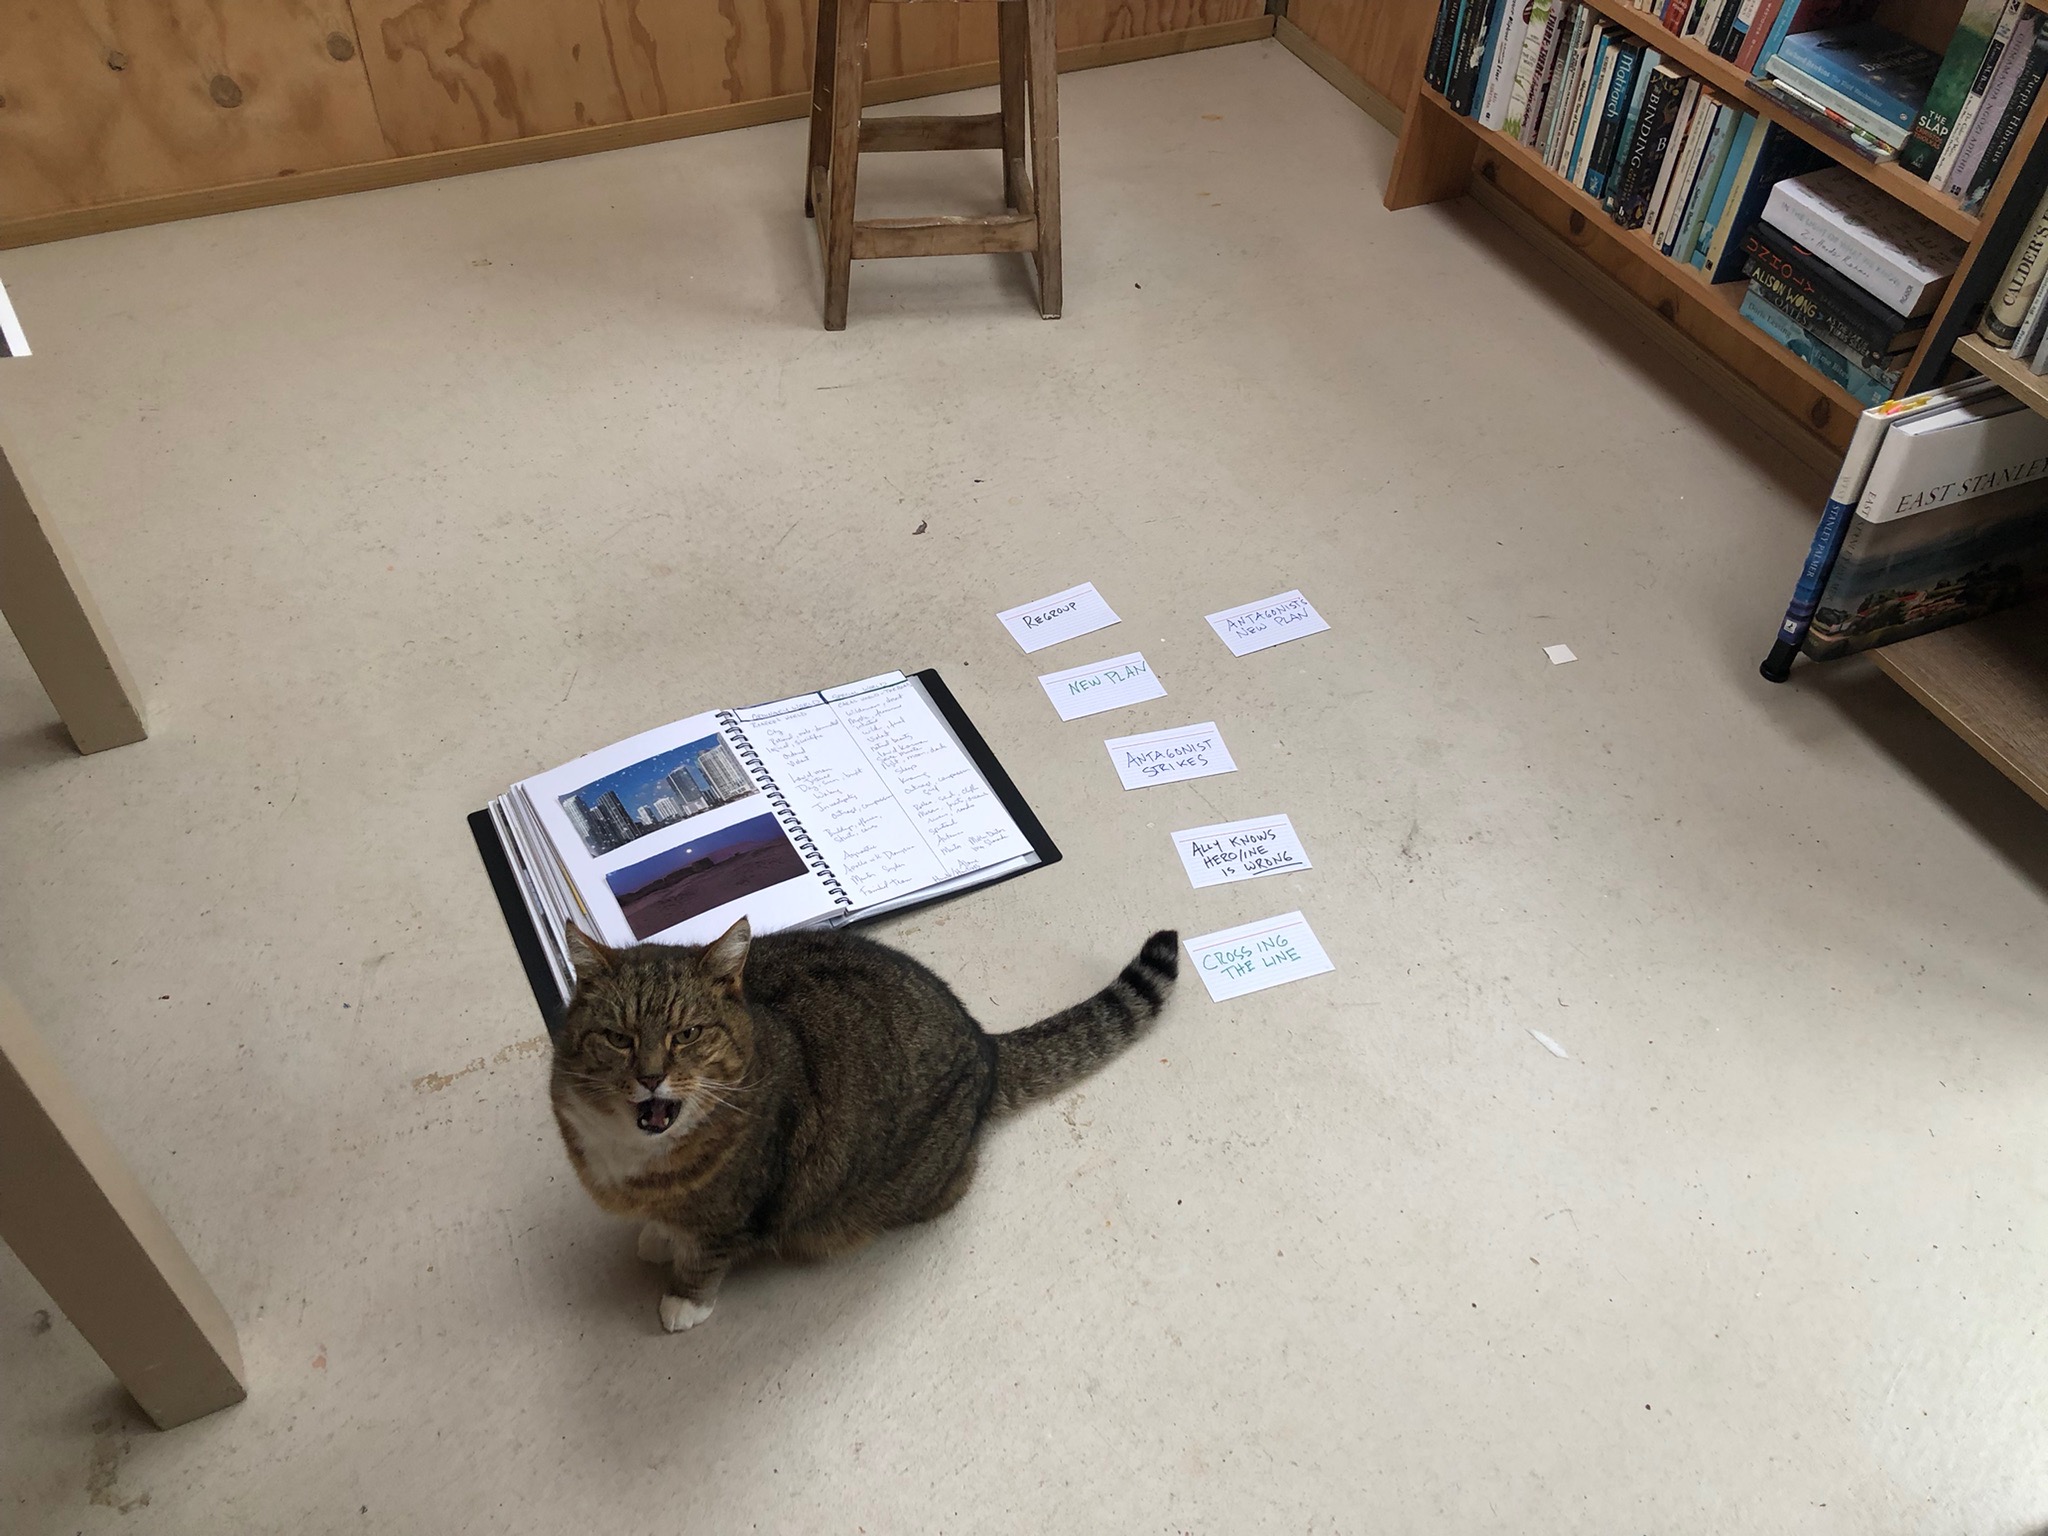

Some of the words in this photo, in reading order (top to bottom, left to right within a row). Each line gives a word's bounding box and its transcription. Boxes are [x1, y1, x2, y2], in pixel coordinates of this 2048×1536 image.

[1550, 57, 1564, 87] JOHN
[1605, 53, 1634, 119] Matriarch
[2012, 71, 2041, 113] Purple
[1629, 92, 1660, 169] BINDING
[1918, 115, 1949, 137] SLAP
[1929, 110, 1947, 125] THE
[1973, 102, 1993, 135] NGOZI
[1954, 135, 1978, 176] ADICHIE
[1990, 114, 2021, 165] Hibiscus
[2000, 223, 2048, 308] CALDER'S
[1751, 265, 1787, 296] ALISON
[1782, 286, 1820, 319] WONG
[1894, 482, 1956, 514] EAST
[1957, 457, 2048, 497] STANLEY
[1859, 491, 1877, 518] EAST
[1819, 503, 1840, 542] STANLEY
[1806, 543, 1825, 578] PALMER
[1023, 601, 1077, 629] REGROUP
[1235, 623, 1267, 639] NEW
[1273, 609, 1309, 628] PLAN
[1068, 672, 1101, 696] NEW
[1104, 660, 1149, 686] PLAN
[1125, 738, 1213, 769] ANTAGONIST
[1142, 754, 1209, 778] STRIKES
[1192, 840, 1220, 857] ALLY
[1229, 829, 1276, 848] KNOWS
[1203, 844, 1269, 869] HERO/INE
[1221, 866, 1236, 877] IS
[1243, 851, 1293, 872] WRONG
[1220, 960, 1256, 981] THE
[1261, 947, 1301, 968] LINE
